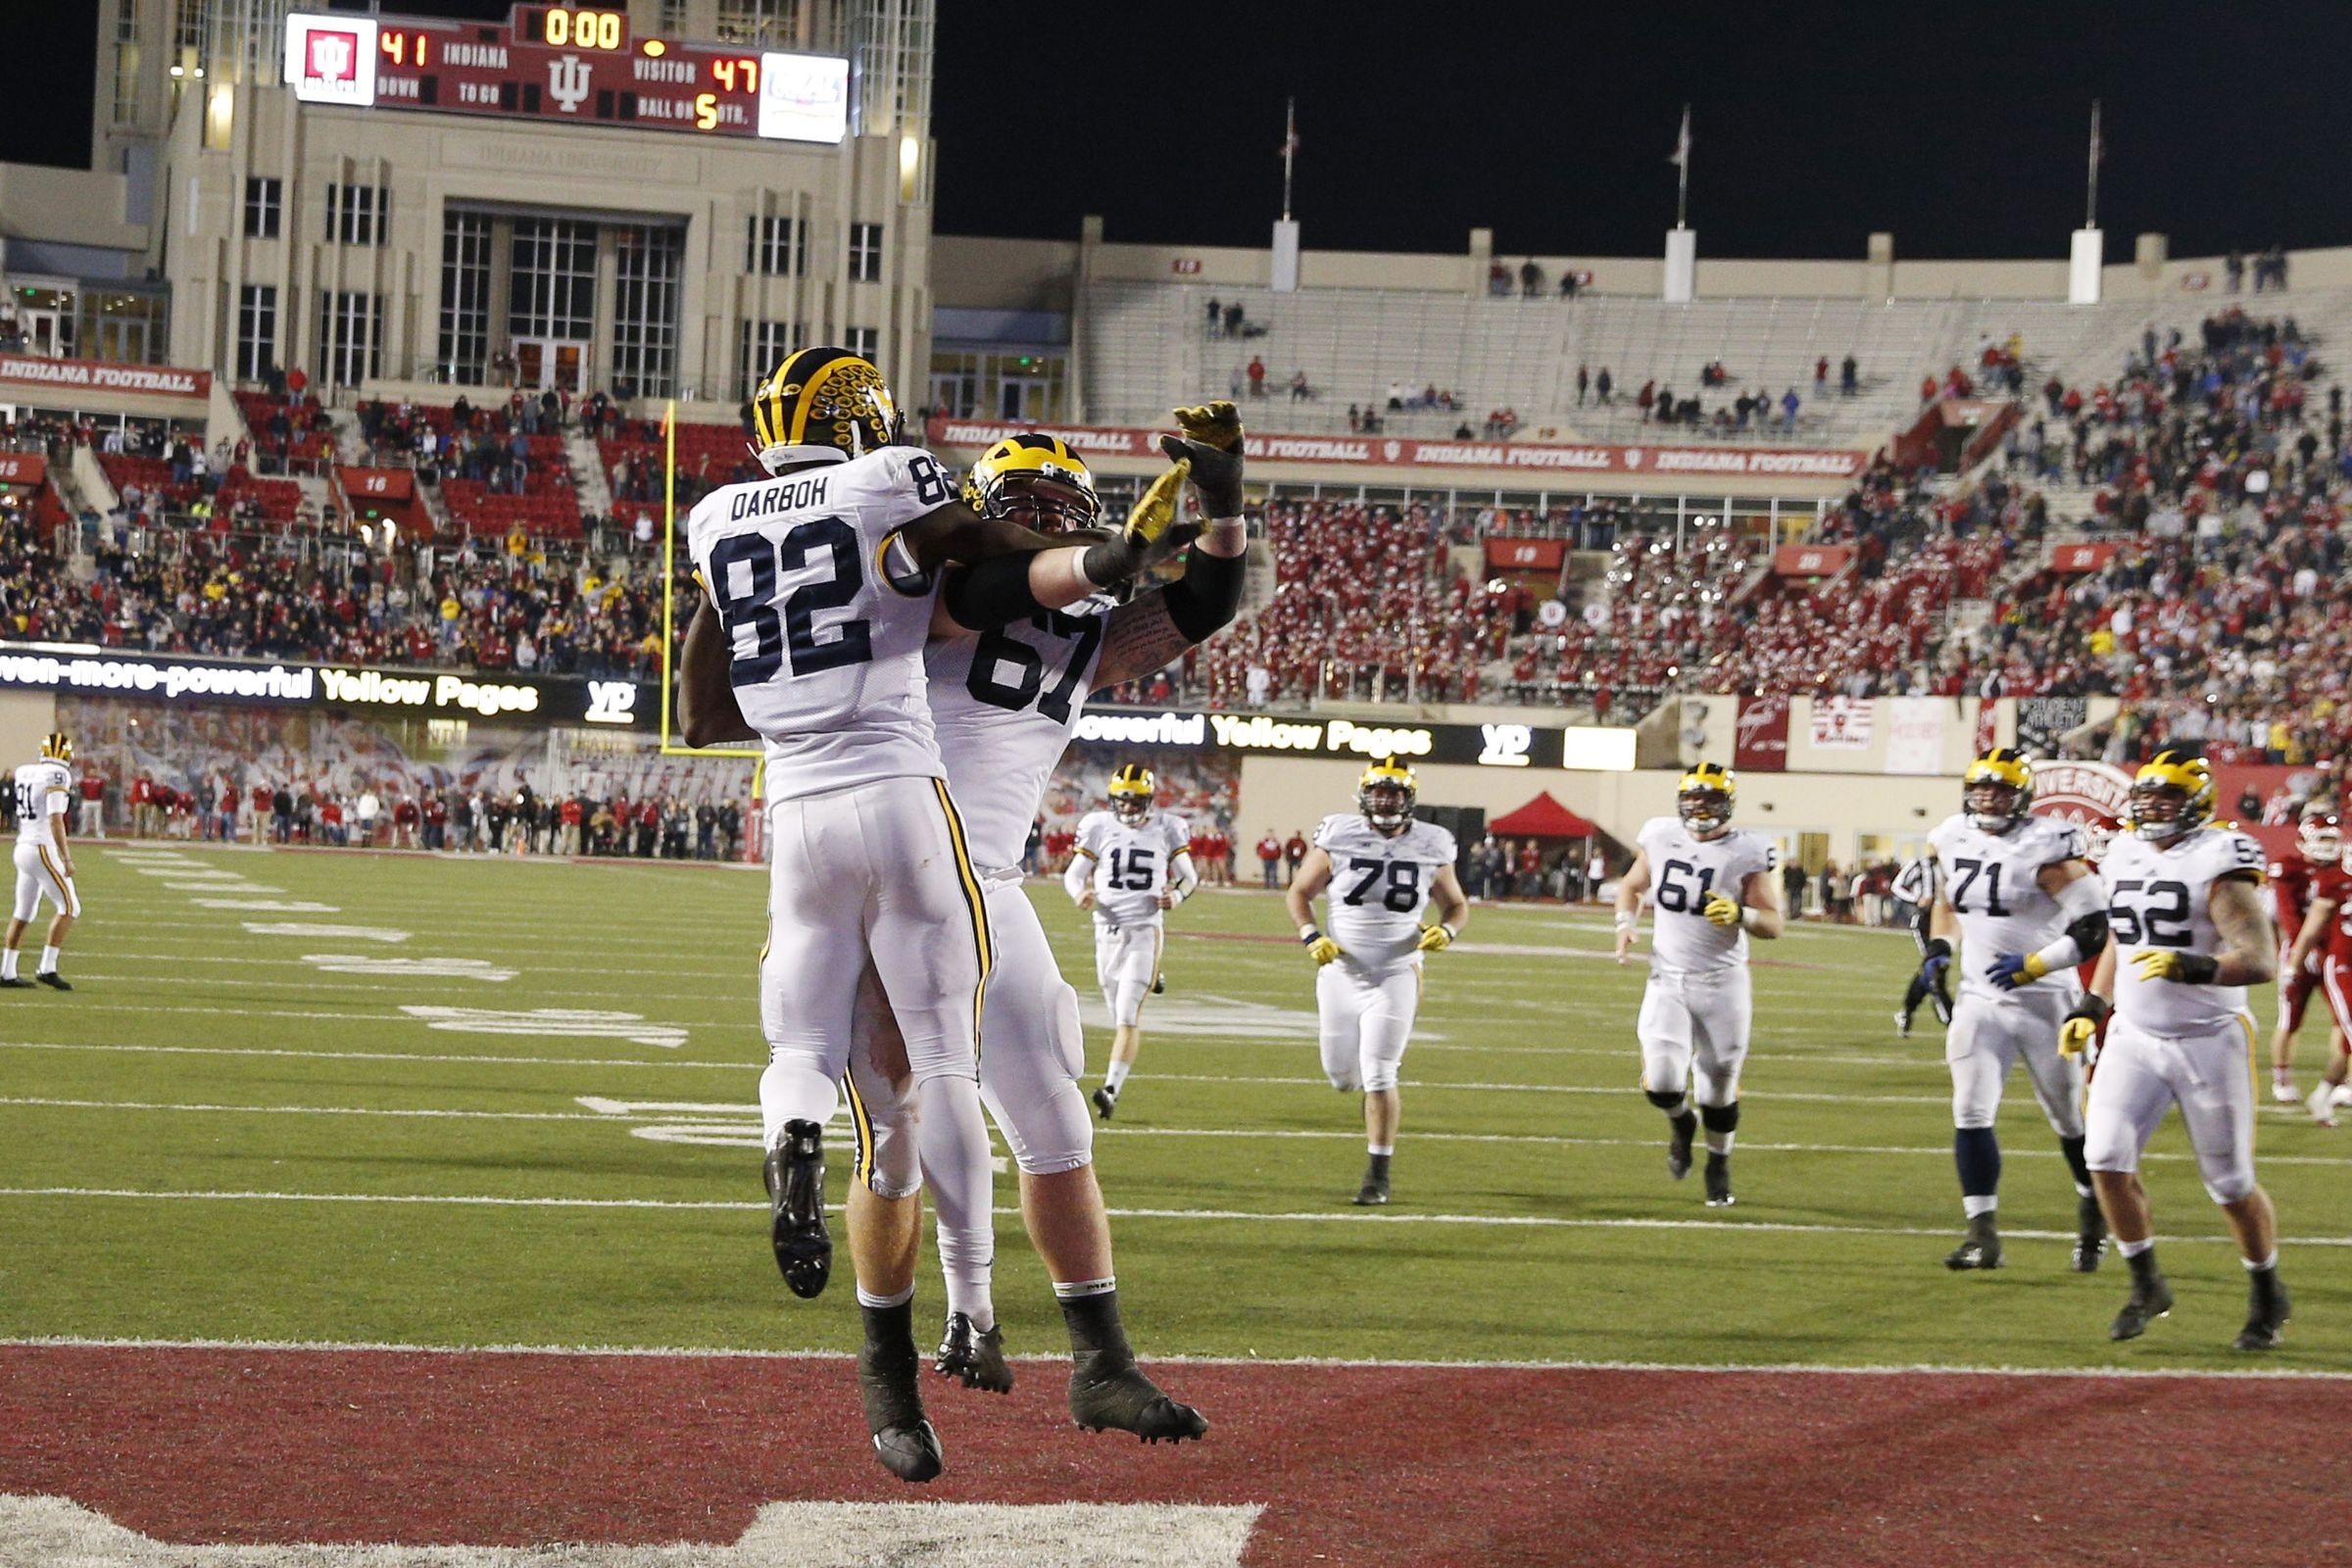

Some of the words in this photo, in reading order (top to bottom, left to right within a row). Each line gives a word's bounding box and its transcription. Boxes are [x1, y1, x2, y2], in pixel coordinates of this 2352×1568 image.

[546, 9, 620, 50] 0:00
[381, 31, 427, 67] 41
[443, 42, 509, 69] INDIANA
[377, 76, 419, 98] DOWN
[633, 58, 697, 84] VISITOR
[712, 59, 758, 93] 47
[638, 98, 672, 118] BALL
[1, 359, 89, 384] INDIANA
[93, 368, 195, 392] FOOTBALL
[944, 424, 1023, 444] INDIAN
[1266, 439, 1370, 461] FOOTBALL
[1414, 444, 1503, 465] INDIANA
[1506, 448, 1610, 467] FOOTBALL
[1655, 451, 1746, 471] INDIANA
[1747, 454, 1856, 473] FOOTBALL
[367, 475, 387, 492] 16
[730, 476, 828, 521] DARBOH
[710, 515, 873, 688] 82
[0, 655, 314, 699] ven-more-powerful
[319, 667, 431, 706] Yellow
[435, 674, 539, 715] Pages
[966, 610, 1102, 726] 67
[1073, 712, 1204, 746] owerful
[1209, 714, 1323, 751] Yellow
[1326, 720, 1433, 760] Pages
[1108, 848, 1154, 891] 15
[1343, 858, 1419, 913] 78
[1657, 858, 1715, 915] 61
[1954, 857, 2012, 917] 71
[2109, 880, 2192, 947] 52
